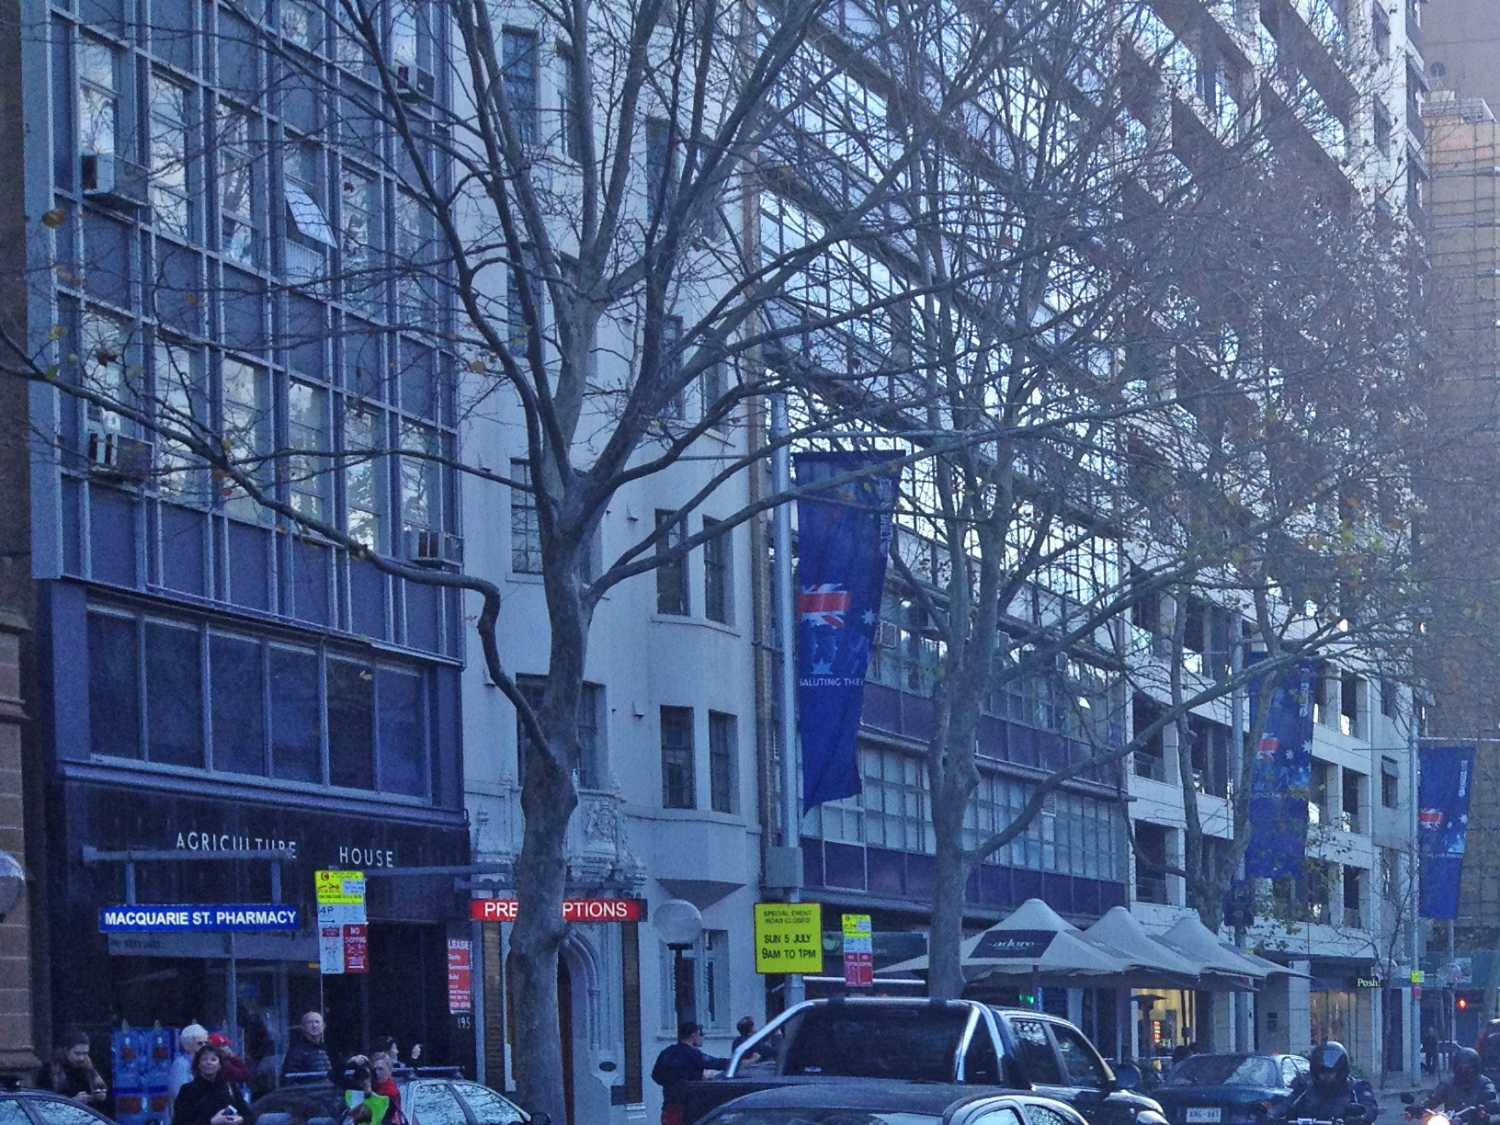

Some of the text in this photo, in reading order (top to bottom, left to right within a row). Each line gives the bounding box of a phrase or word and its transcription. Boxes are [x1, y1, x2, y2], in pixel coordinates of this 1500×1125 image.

[339, 846, 394, 868] HOUSE
[104, 910, 297, 926] MACQUARIE ST. PHARMACY
[763, 933, 811, 944] SUN 5 JULY
[762, 947, 816, 960] 9AM TO 1PM
